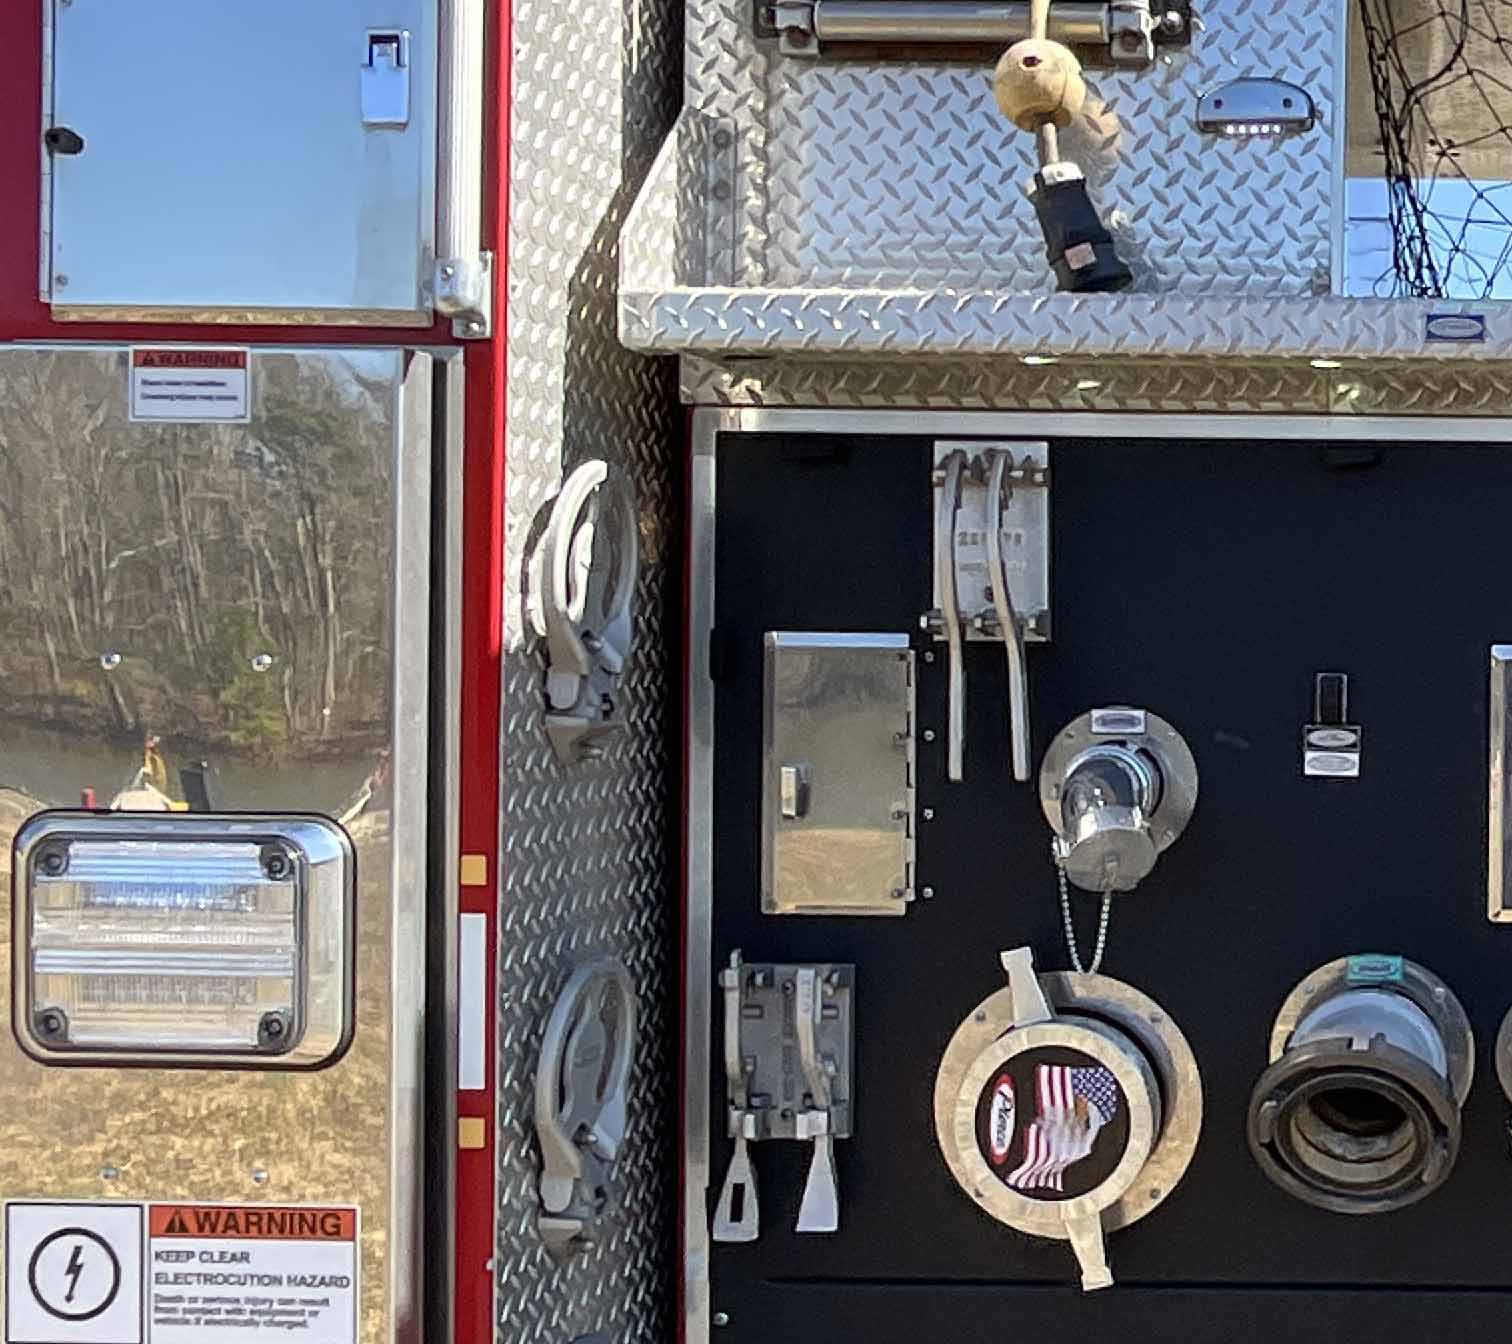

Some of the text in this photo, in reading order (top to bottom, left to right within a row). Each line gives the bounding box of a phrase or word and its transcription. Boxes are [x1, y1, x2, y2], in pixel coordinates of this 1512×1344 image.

[194, 1211, 342, 1236] WARNING
[154, 1250, 251, 1264] KEEP CLEAR
[154, 1272, 351, 1289] ELECTROCUTION HAZARD
